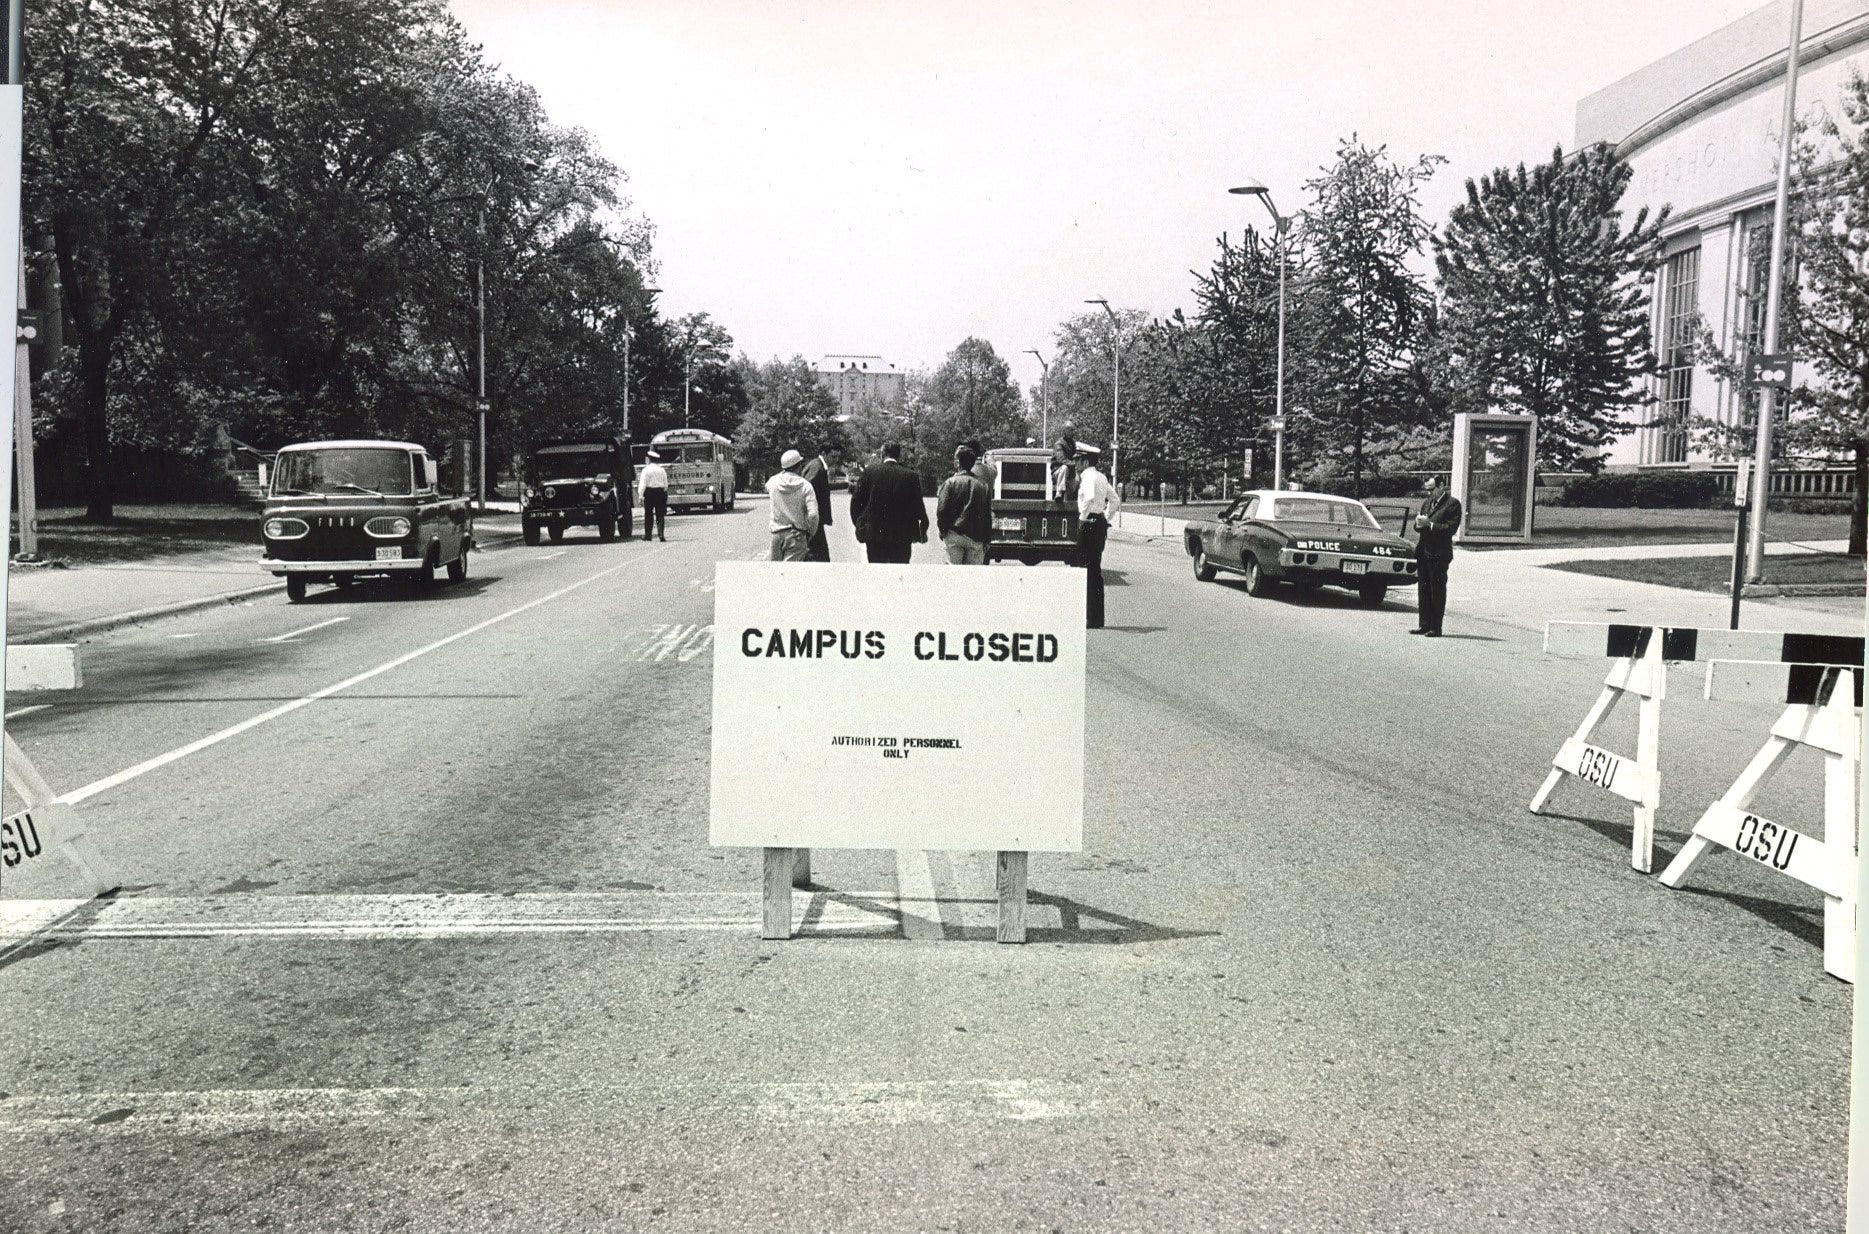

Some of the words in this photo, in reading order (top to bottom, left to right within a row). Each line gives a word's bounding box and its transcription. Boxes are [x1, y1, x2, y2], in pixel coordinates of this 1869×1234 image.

[1308, 541, 1340, 551] POLICE
[741, 628, 885, 659] CAMPUS
[914, 631, 1058, 662] CLOSED
[831, 736, 897, 747] AUTHORIZED
[903, 738, 962, 749] PERSONNEL
[883, 749, 909, 758] ONLY
[1578, 748, 1619, 789] OSU
[1735, 815, 1799, 870] OSU
